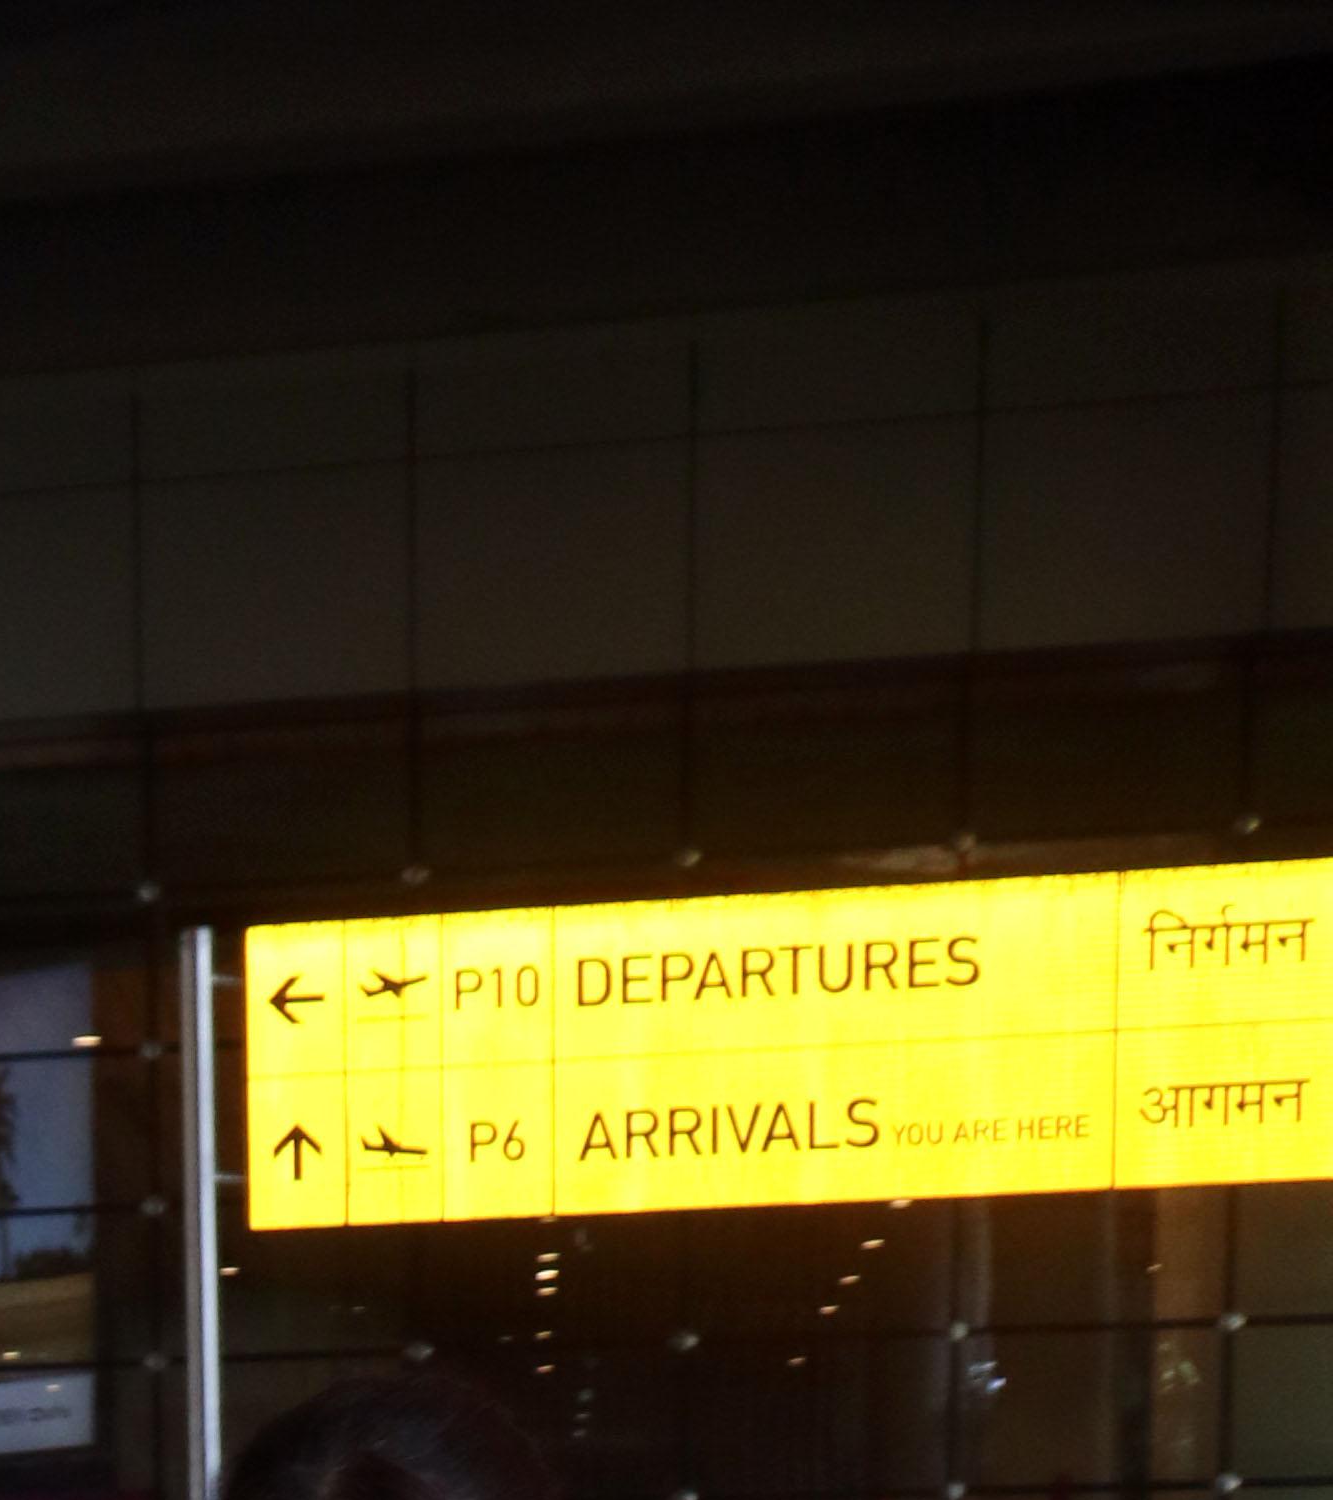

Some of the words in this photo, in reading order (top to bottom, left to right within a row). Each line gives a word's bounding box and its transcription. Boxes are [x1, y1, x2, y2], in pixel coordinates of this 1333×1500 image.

[1144, 904, 1315, 970] निर्गमन
[455, 966, 540, 1010] P10
[577, 936, 982, 1008] DEPARTURES
[469, 1119, 526, 1163] P6
[579, 1096, 880, 1162] ARRIVALS
[892, 1120, 944, 1147] YOU
[952, 1117, 1007, 1144] ARE
[1017, 1113, 1091, 1141] HERE
[1140, 1079, 1311, 1129] आगमन
